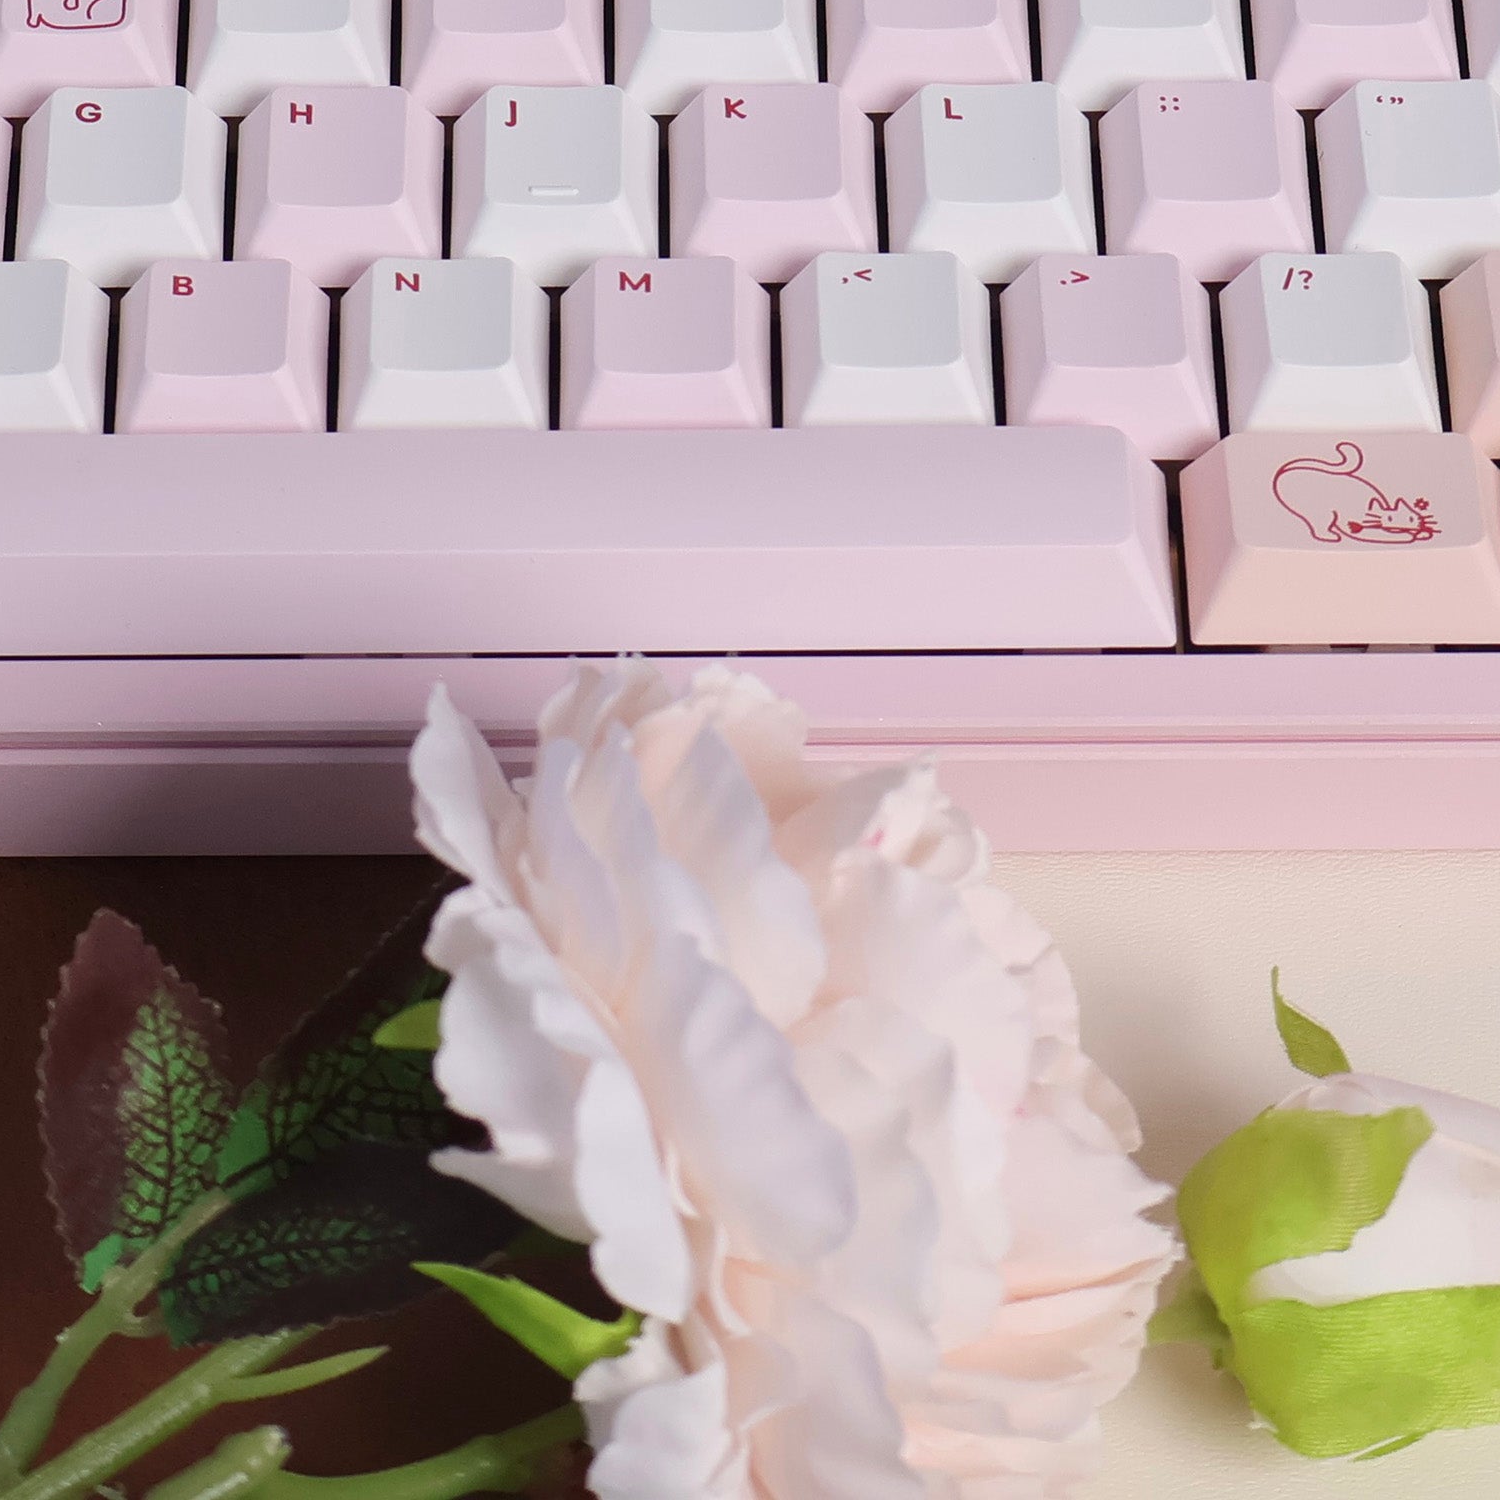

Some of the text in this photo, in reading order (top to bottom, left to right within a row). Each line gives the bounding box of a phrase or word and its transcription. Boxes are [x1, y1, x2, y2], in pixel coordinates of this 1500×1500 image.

[74, 101, 103, 124] G
[289, 101, 314, 126] H
[503, 99, 518, 129] J
[723, 96, 748, 120] K
[942, 96, 964, 121] L
[171, 274, 195, 297] B
[394, 271, 421, 293] N
[618, 270, 652, 294] M
[1281, 266, 1314, 291] /?
